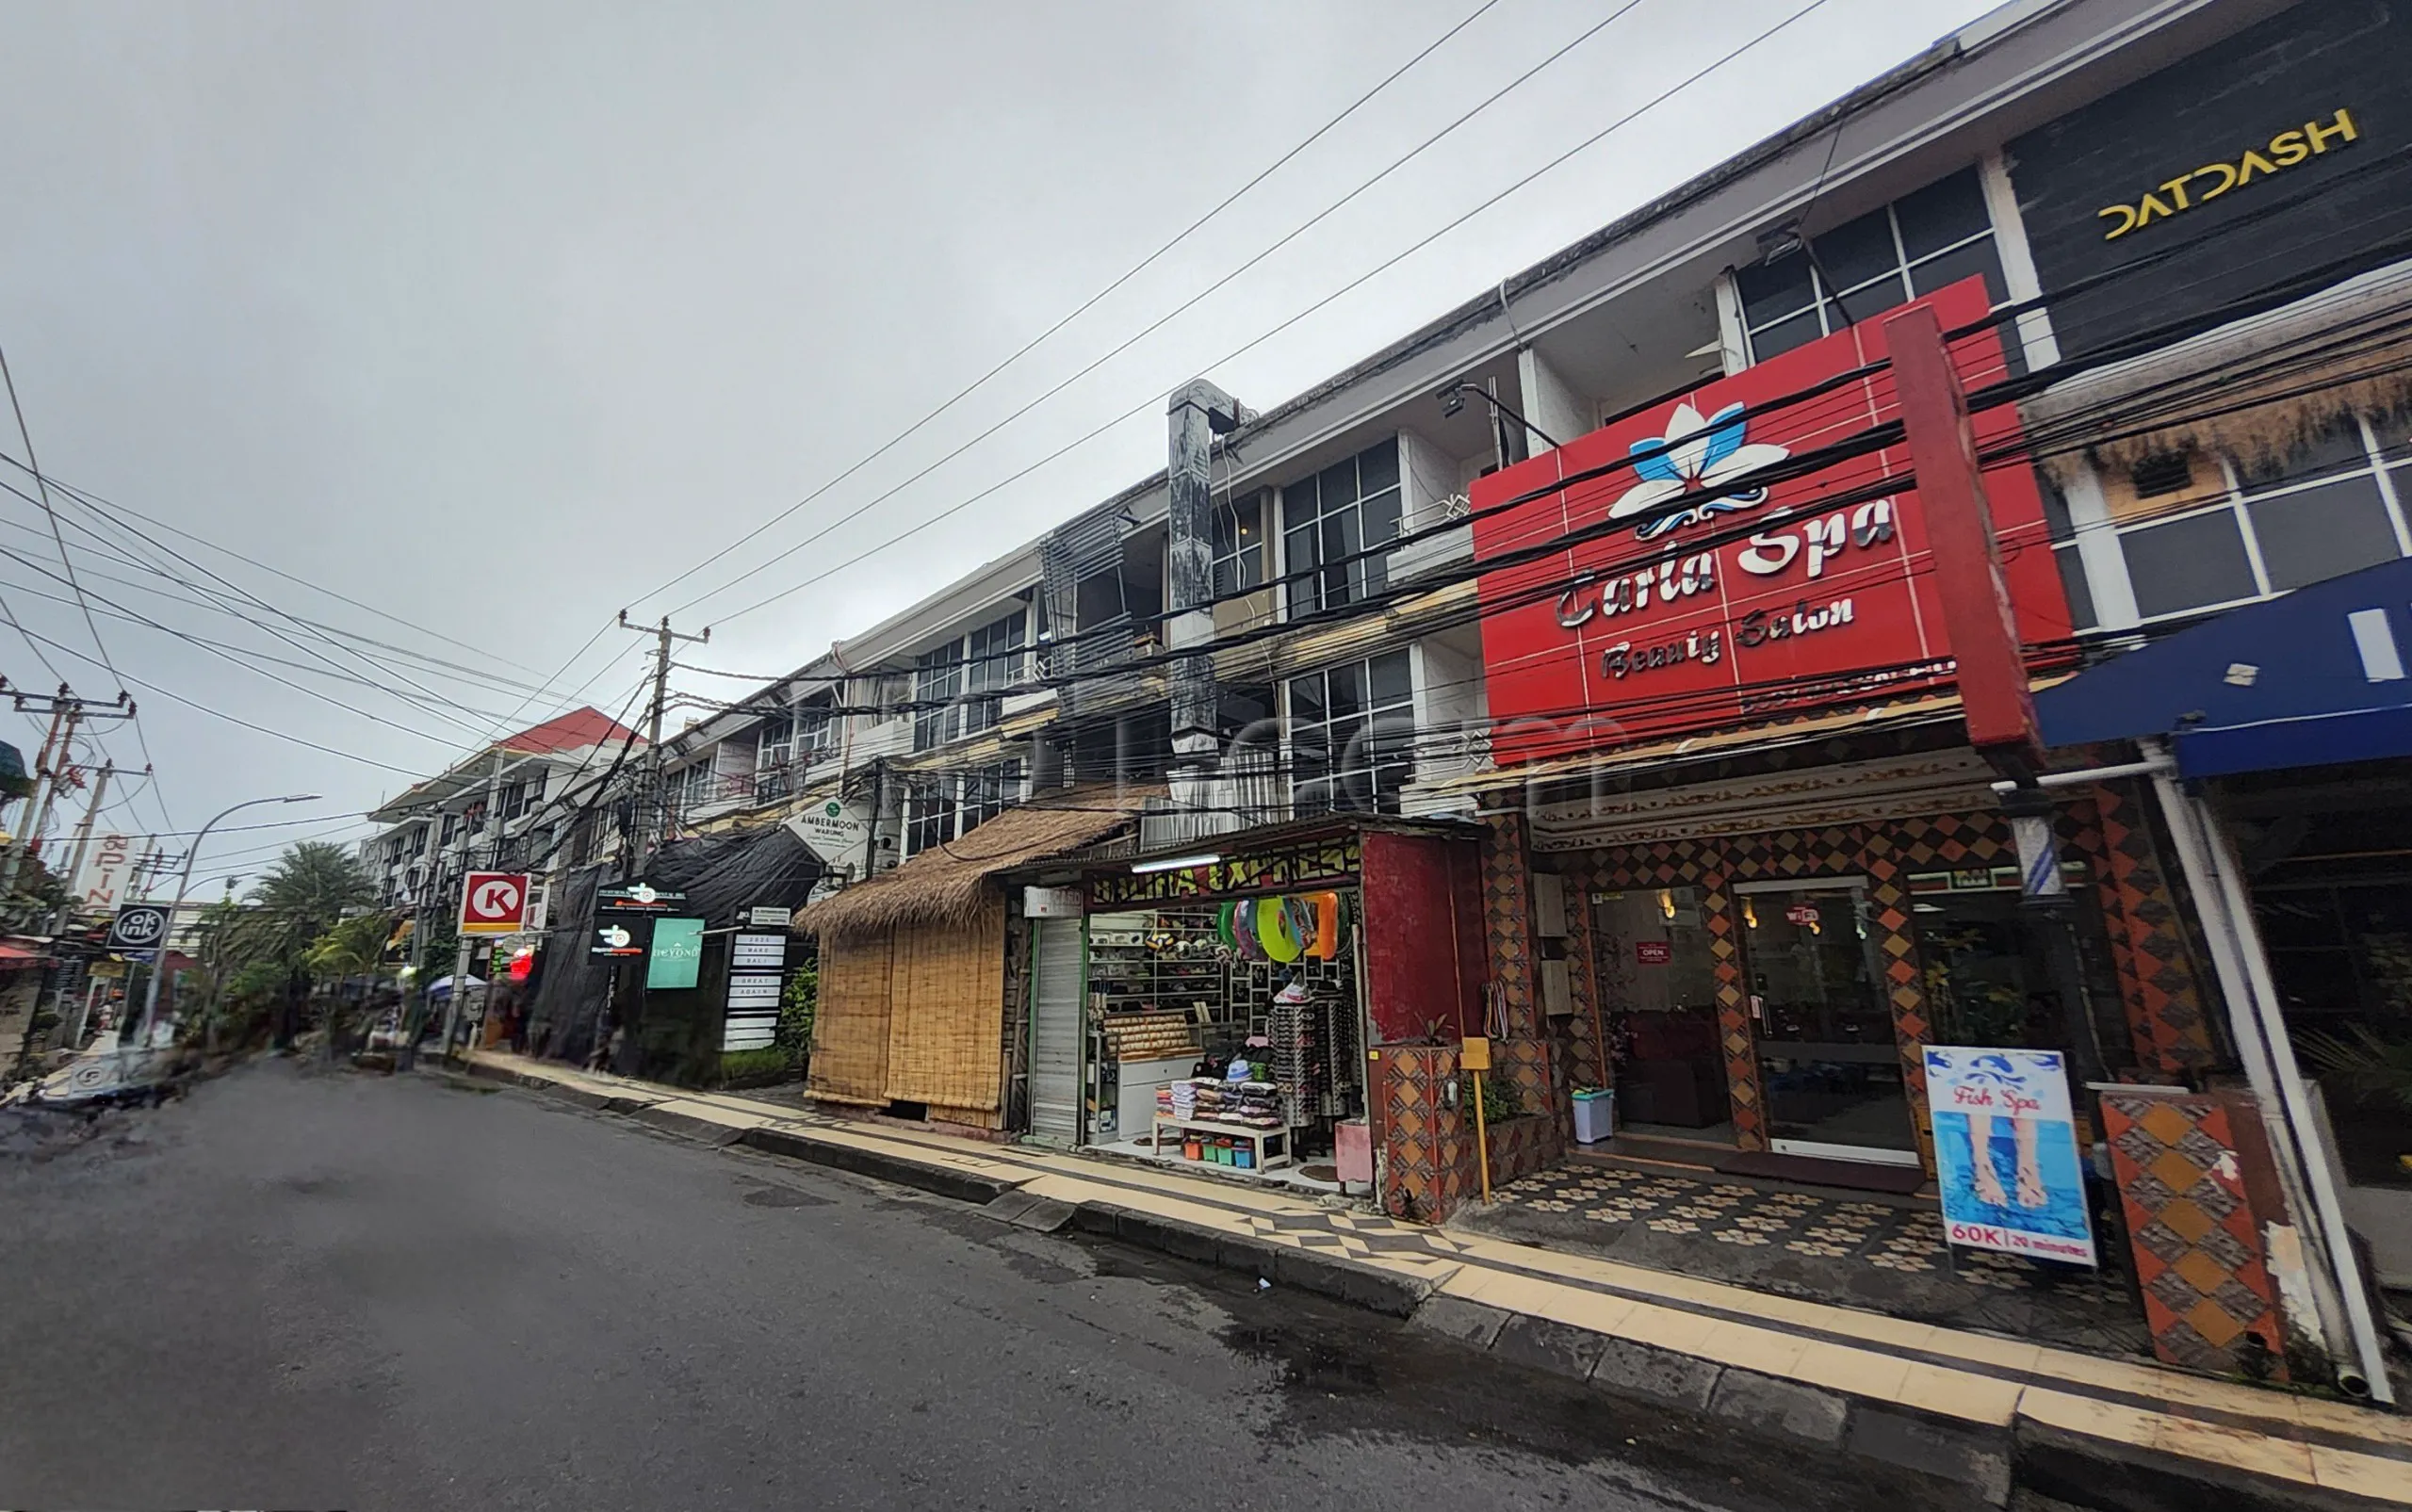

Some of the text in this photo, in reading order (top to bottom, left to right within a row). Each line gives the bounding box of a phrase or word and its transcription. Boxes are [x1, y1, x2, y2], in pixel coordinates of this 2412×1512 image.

[1556, 498, 1895, 627] Carla Spa
[1601, 597, 1854, 678] Beauty Salon
[800, 815, 860, 832] AMBERMOON
[814, 827, 845, 837] WARUNG
[1953, 1085, 2042, 1116] Fish Spa
[1951, 1223, 2002, 1246] 60K
